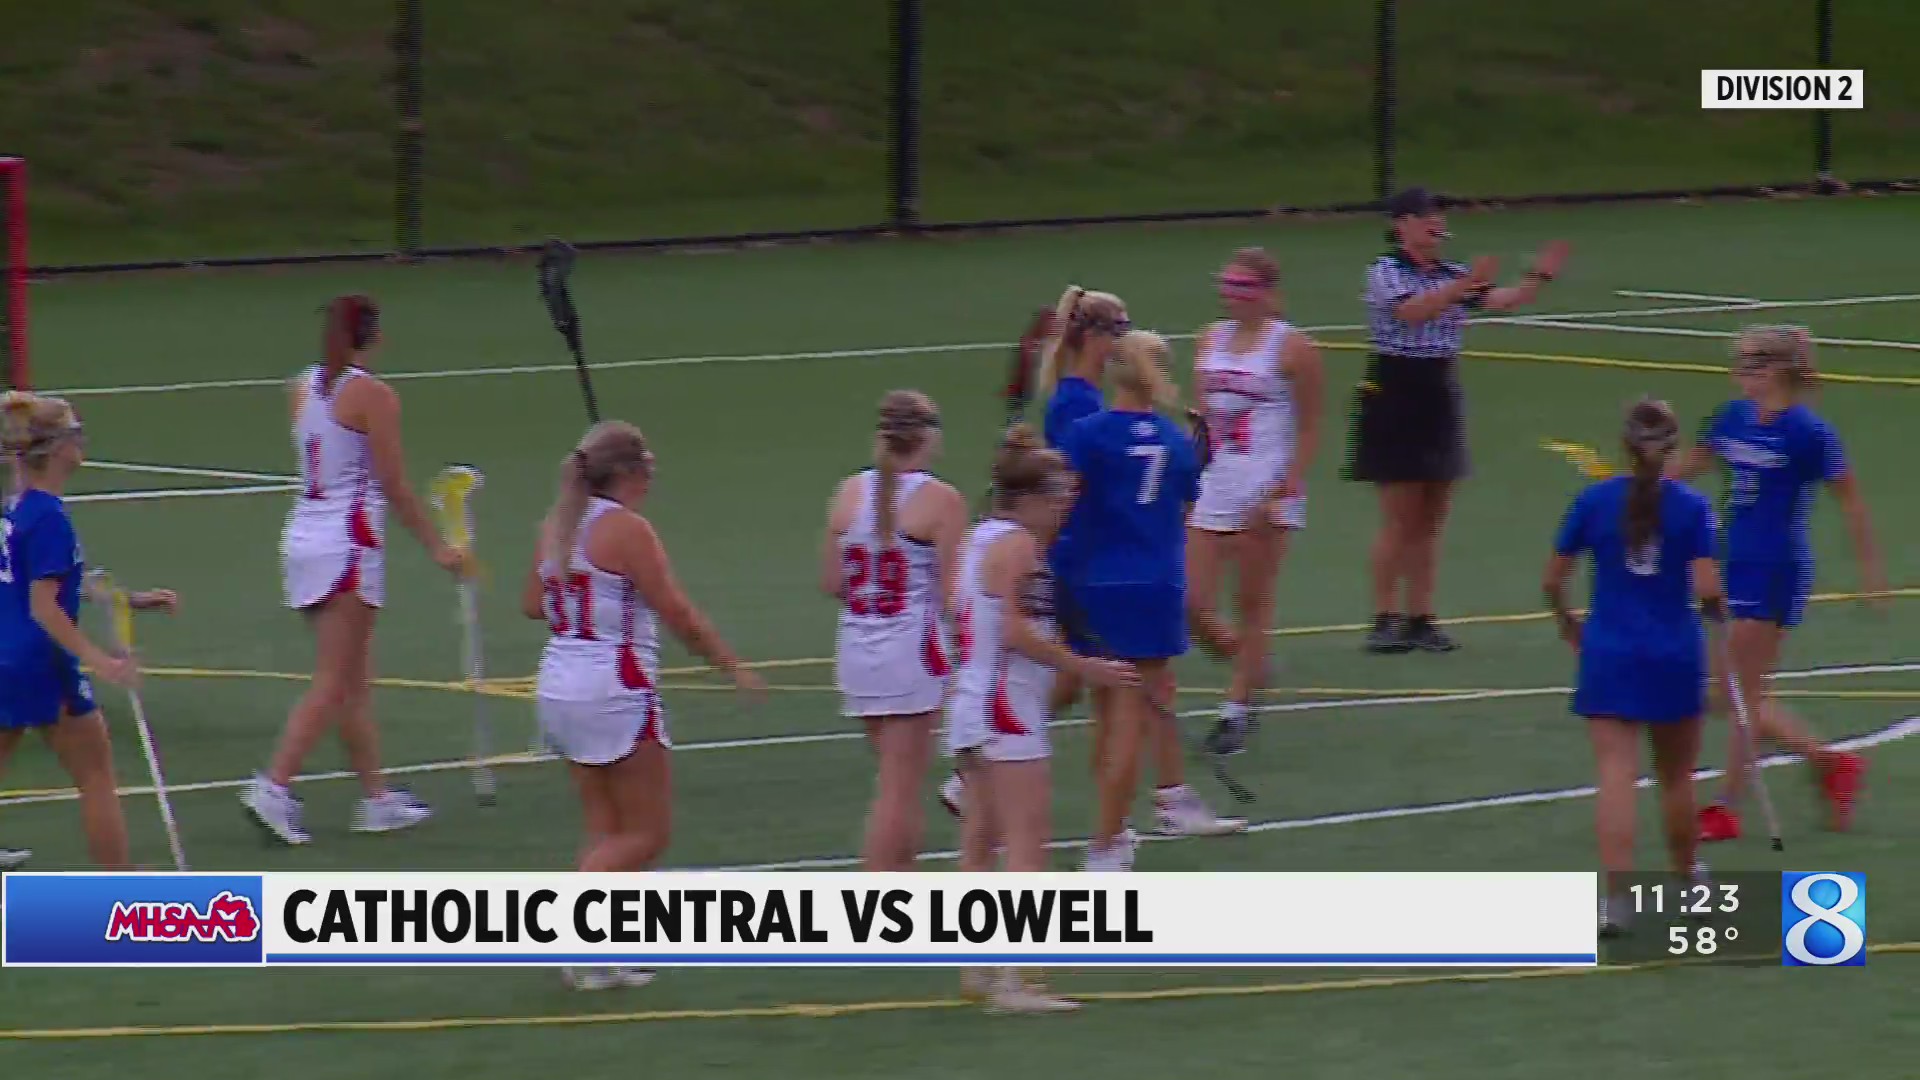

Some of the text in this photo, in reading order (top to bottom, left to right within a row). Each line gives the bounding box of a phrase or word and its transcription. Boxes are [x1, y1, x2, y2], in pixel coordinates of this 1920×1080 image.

[304, 432, 328, 499] 1
[1124, 445, 1169, 504] 7
[846, 543, 909, 617] 29
